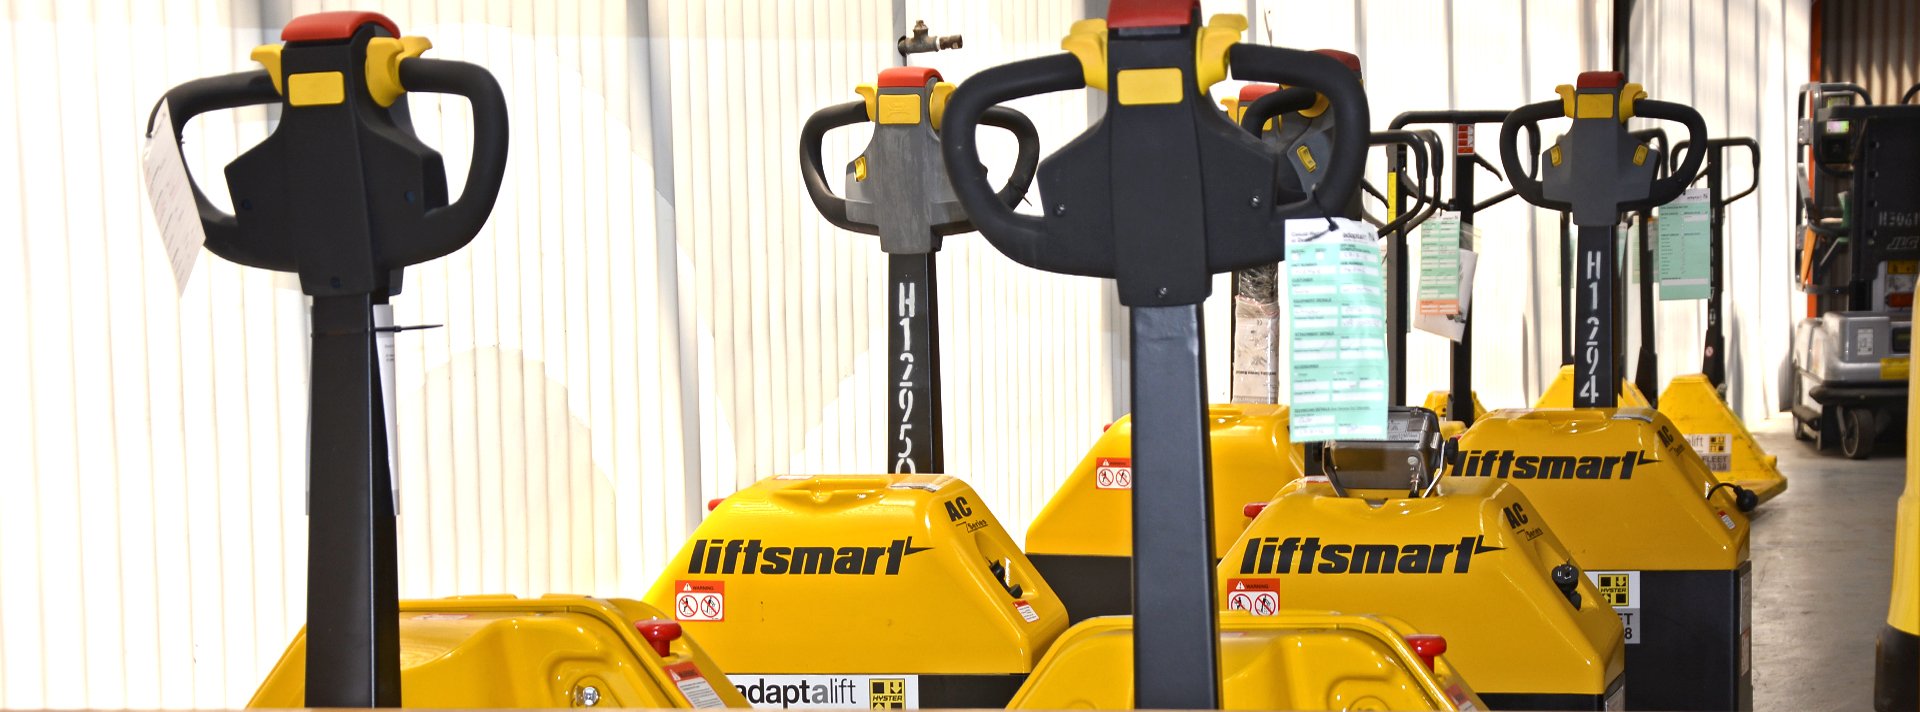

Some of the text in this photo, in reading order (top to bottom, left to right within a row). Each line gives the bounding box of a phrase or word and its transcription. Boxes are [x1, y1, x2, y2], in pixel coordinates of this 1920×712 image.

[1450, 450, 1638, 480] liftsmart
[944, 496, 972, 522] AC
[1503, 502, 1528, 529] AC
[968, 519, 987, 531] Series
[688, 538, 906, 575] liftsmart
[1240, 536, 1477, 574] liftsmart
